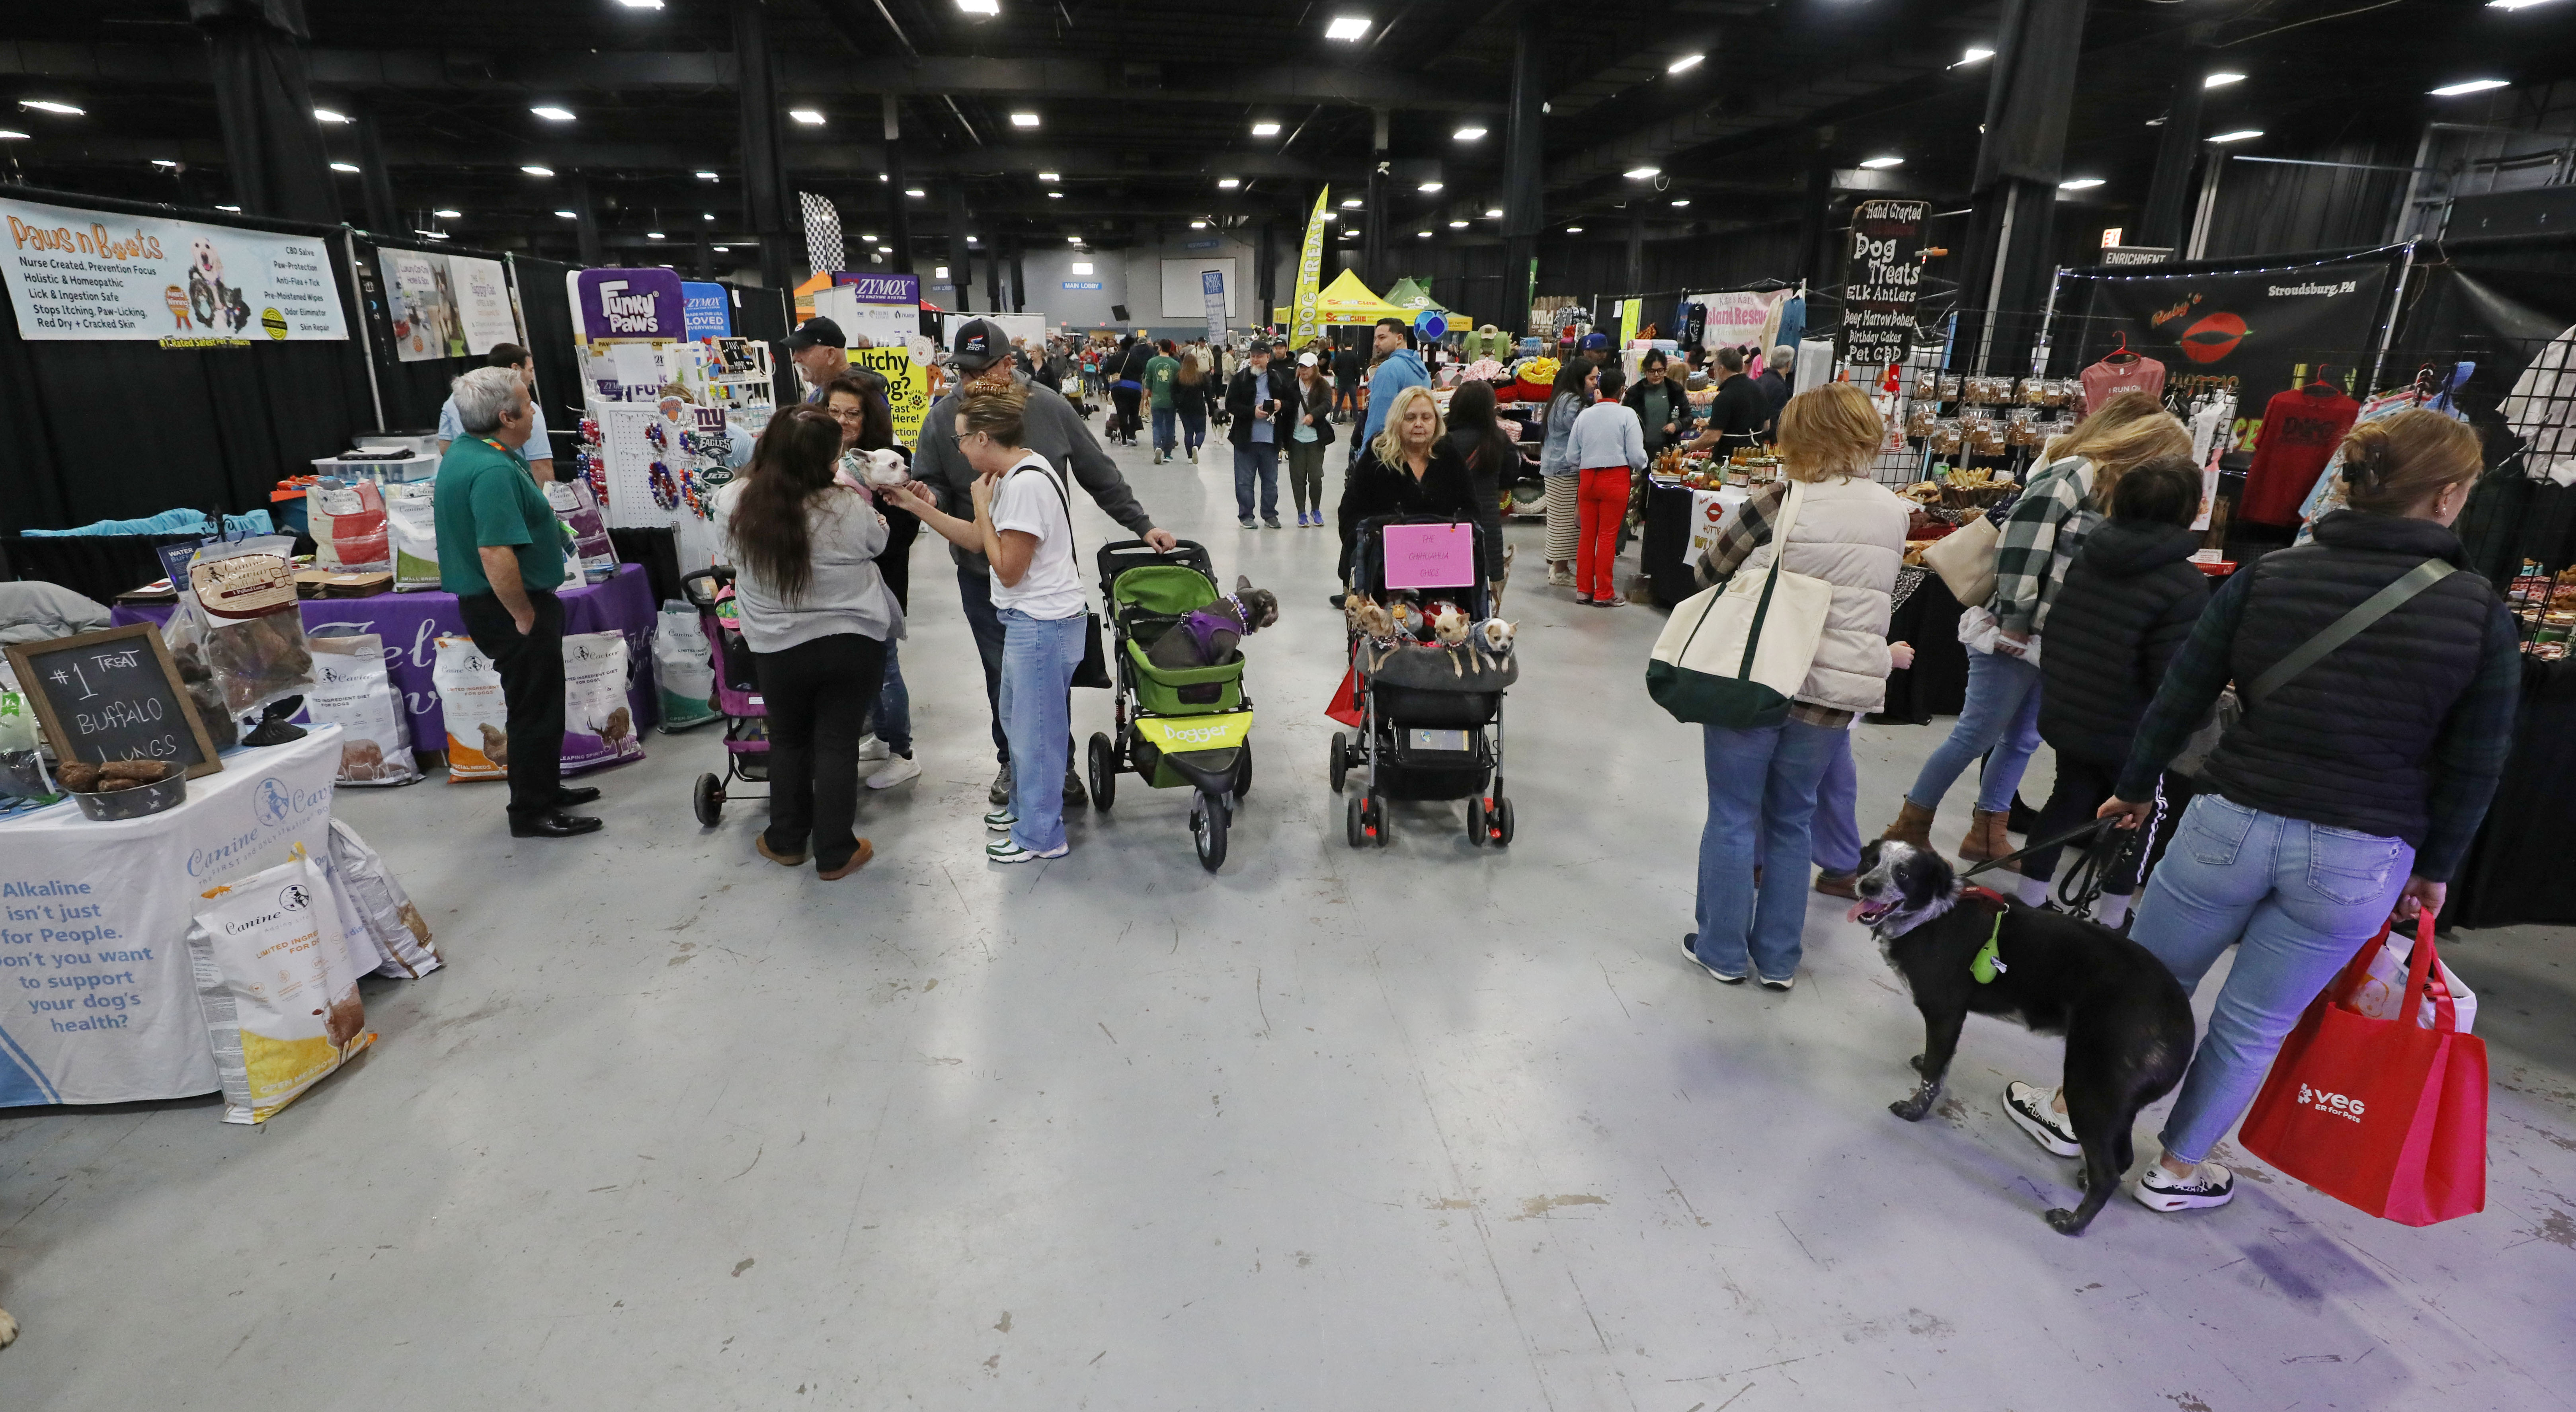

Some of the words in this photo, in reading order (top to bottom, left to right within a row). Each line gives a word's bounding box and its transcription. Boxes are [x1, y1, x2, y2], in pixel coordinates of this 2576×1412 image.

[1867, 202, 1889, 218] Hand
[1890, 203, 1923, 223] Crafted
[7, 215, 75, 253] Paws
[76, 232, 94, 254] n
[286, 246, 297, 255] CBD
[299, 248, 314, 256] Salve
[1303, 209, 1324, 285] TREATS
[1854, 232, 1897, 263] Dog
[19, 257, 47, 267] Nurse
[50, 260, 86, 271] Created,
[88, 262, 131, 274] Prevention
[134, 265, 156, 275] Focus
[273, 261, 317, 271] Paw-Protection
[2106, 252, 2166, 264] ENRICHMENT
[1868, 258, 1920, 286] Treats
[24, 273, 59, 284] Holistic
[62, 275, 68, 284] &
[70, 276, 124, 289] Homeopathic
[276, 277, 303, 286] Anti-Flea
[857, 279, 910, 295] ZYMOX
[29, 289, 48, 299] Lick
[51, 290, 57, 299] &
[60, 291, 99, 303] Ingestion
[101, 293, 119, 302] Safe
[264, 291, 306, 301] Pre-Moistened
[307, 293, 323, 302] Wipes
[599, 280, 655, 318] Funky
[688, 297, 720, 307] ZYMOX
[34, 305, 60, 318] Stops
[63, 306, 96, 318] Itching,
[1298, 292, 1317, 336] DOG
[1532, 310, 1553, 325] Wild
[1844, 308, 1862, 328] Beef
[1862, 310, 1891, 326] Marrow
[1891, 309, 1914, 327] Bones
[38, 318, 55, 328] Red
[58, 320, 72, 330] Dry
[83, 320, 117, 329] Cracked
[119, 320, 136, 328] Skin
[313, 324, 329, 333] Repair
[609, 314, 658, 333] Paws
[687, 316, 724, 325] LOVED
[195, 338, 216, 347] Safest
[1849, 330, 1879, 345] Birthday
[1881, 331, 1902, 343] Cakes
[1850, 345, 1869, 362] Pet
[1874, 345, 1901, 362] CBD
[862, 351, 909, 376] Itchy
[890, 404, 910, 413] Fast
[893, 414, 919, 423] Here!
[699, 437, 732, 451] EAGLES
[168, 548, 194, 557] WATER
[590, 651, 619, 659] Caviar
[50, 663, 99, 701] #1
[90, 649, 140, 673] TREAT
[1164, 724, 1227, 743] Dogger
[187, 828, 257, 876] Canine
[213, 859, 240, 874] FIRST
[244, 848, 256, 860] and
[259, 835, 277, 850] ONLY
[3, 880, 91, 897] Alkaline
[6, 905, 54, 921] isn't
[59, 904, 101, 922] just
[226, 912, 280, 935] Canine
[265, 922, 292, 932] Adding
[1, 929, 33, 944] for
[40, 925, 123, 945] People.
[256, 942, 288, 959] LIMITED
[290, 944, 309, 954] FOR
[52, 953, 92, 969] you
[98, 948, 153, 962] want
[19, 976, 41, 989] to
[47, 971, 135, 990] support
[28, 999, 75, 1014] your
[84, 992, 141, 1010] dog's
[50, 1014, 128, 1033] health?
[260, 1080, 293, 1093] OPEN
[2343, 1112, 2361, 1123] Pets
